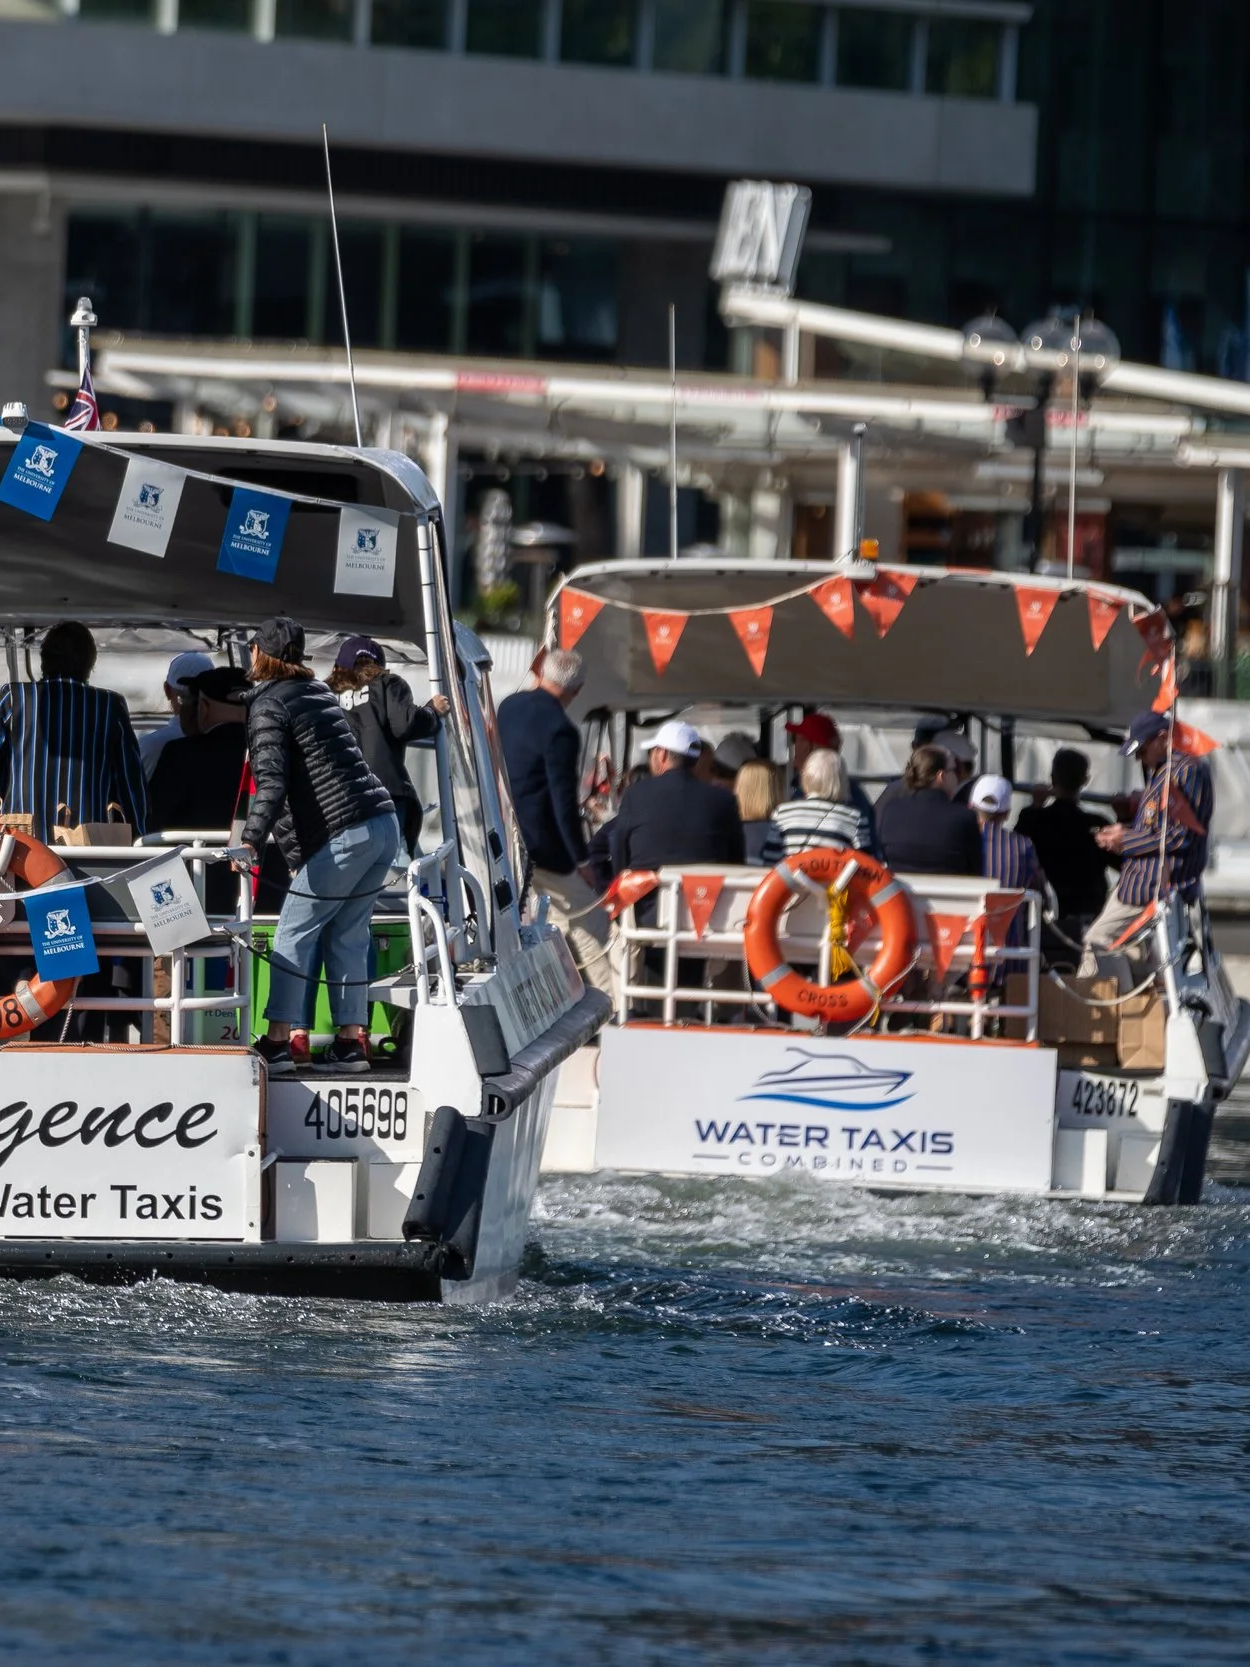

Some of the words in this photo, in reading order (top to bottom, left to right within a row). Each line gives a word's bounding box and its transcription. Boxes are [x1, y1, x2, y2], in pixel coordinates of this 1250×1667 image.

[13, 473, 53, 494] MELBOURNE
[123, 513, 163, 529] MELBOURNE
[230, 541, 271, 556] MELBOURNE
[345, 562, 385, 571] MELBOURNE
[153, 909, 193, 929] MELBOURNE
[43, 942, 85, 957] MELBOURNE
[797, 989, 848, 1008] CROSS
[1072, 1079, 1140, 1118] 423872
[304, 1087, 408, 1141] 405698
[694, 1119, 830, 1149] WATER
[841, 1126, 955, 1155] TAXIS
[737, 1152, 908, 1173] COMBINED
[110, 1184, 224, 1221] Taxis
